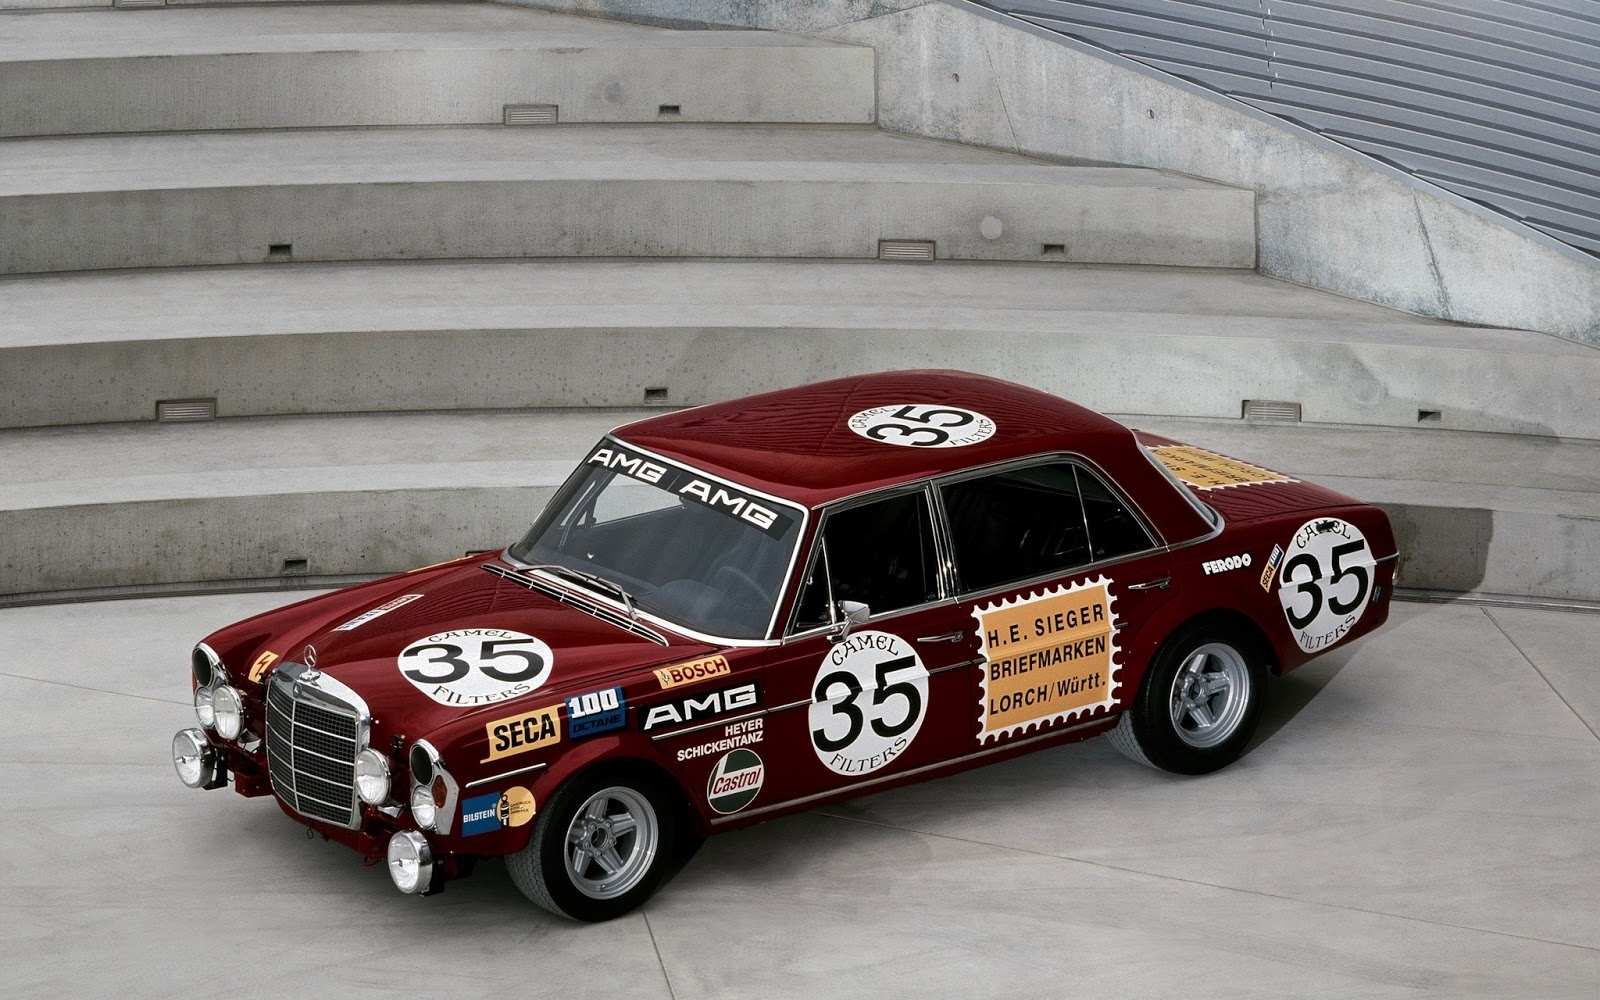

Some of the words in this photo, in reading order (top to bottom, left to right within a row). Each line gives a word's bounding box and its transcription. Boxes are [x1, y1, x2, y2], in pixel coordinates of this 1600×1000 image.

[851, 407, 896, 428] CAMEL
[866, 405, 975, 447] 35
[949, 418, 993, 446] FILTERS
[587, 448, 668, 484] AMG
[678, 479, 779, 530] AMG
[1202, 553, 1252, 575] FERODO
[1262, 566, 1274, 588] SECA
[1282, 538, 1369, 631] 35
[428, 629, 512, 643] CAMEL
[1034, 603, 1104, 637] SIEGER
[1299, 614, 1356, 650] FILTERS
[403, 638, 545, 684] 35
[831, 634, 899, 666] CAMEL
[990, 635, 1105, 682] BRIEFMARKEN
[668, 657, 728, 683] BOSCH
[432, 683, 531, 705] FILTERS
[568, 688, 620, 719] 100
[643, 683, 757, 730] AMG
[812, 654, 922, 753] 35
[989, 672, 1106, 716] LORCH/Württ.
[493, 713, 556, 752] SECA
[573, 713, 621, 734] OCTANE
[725, 718, 763, 737] HEYER
[676, 730, 763, 762] SCHICKENTANZ
[829, 736, 907, 773] FILTERS
[712, 767, 762, 795] Castrol
[463, 808, 496, 823] BILSTEIN
